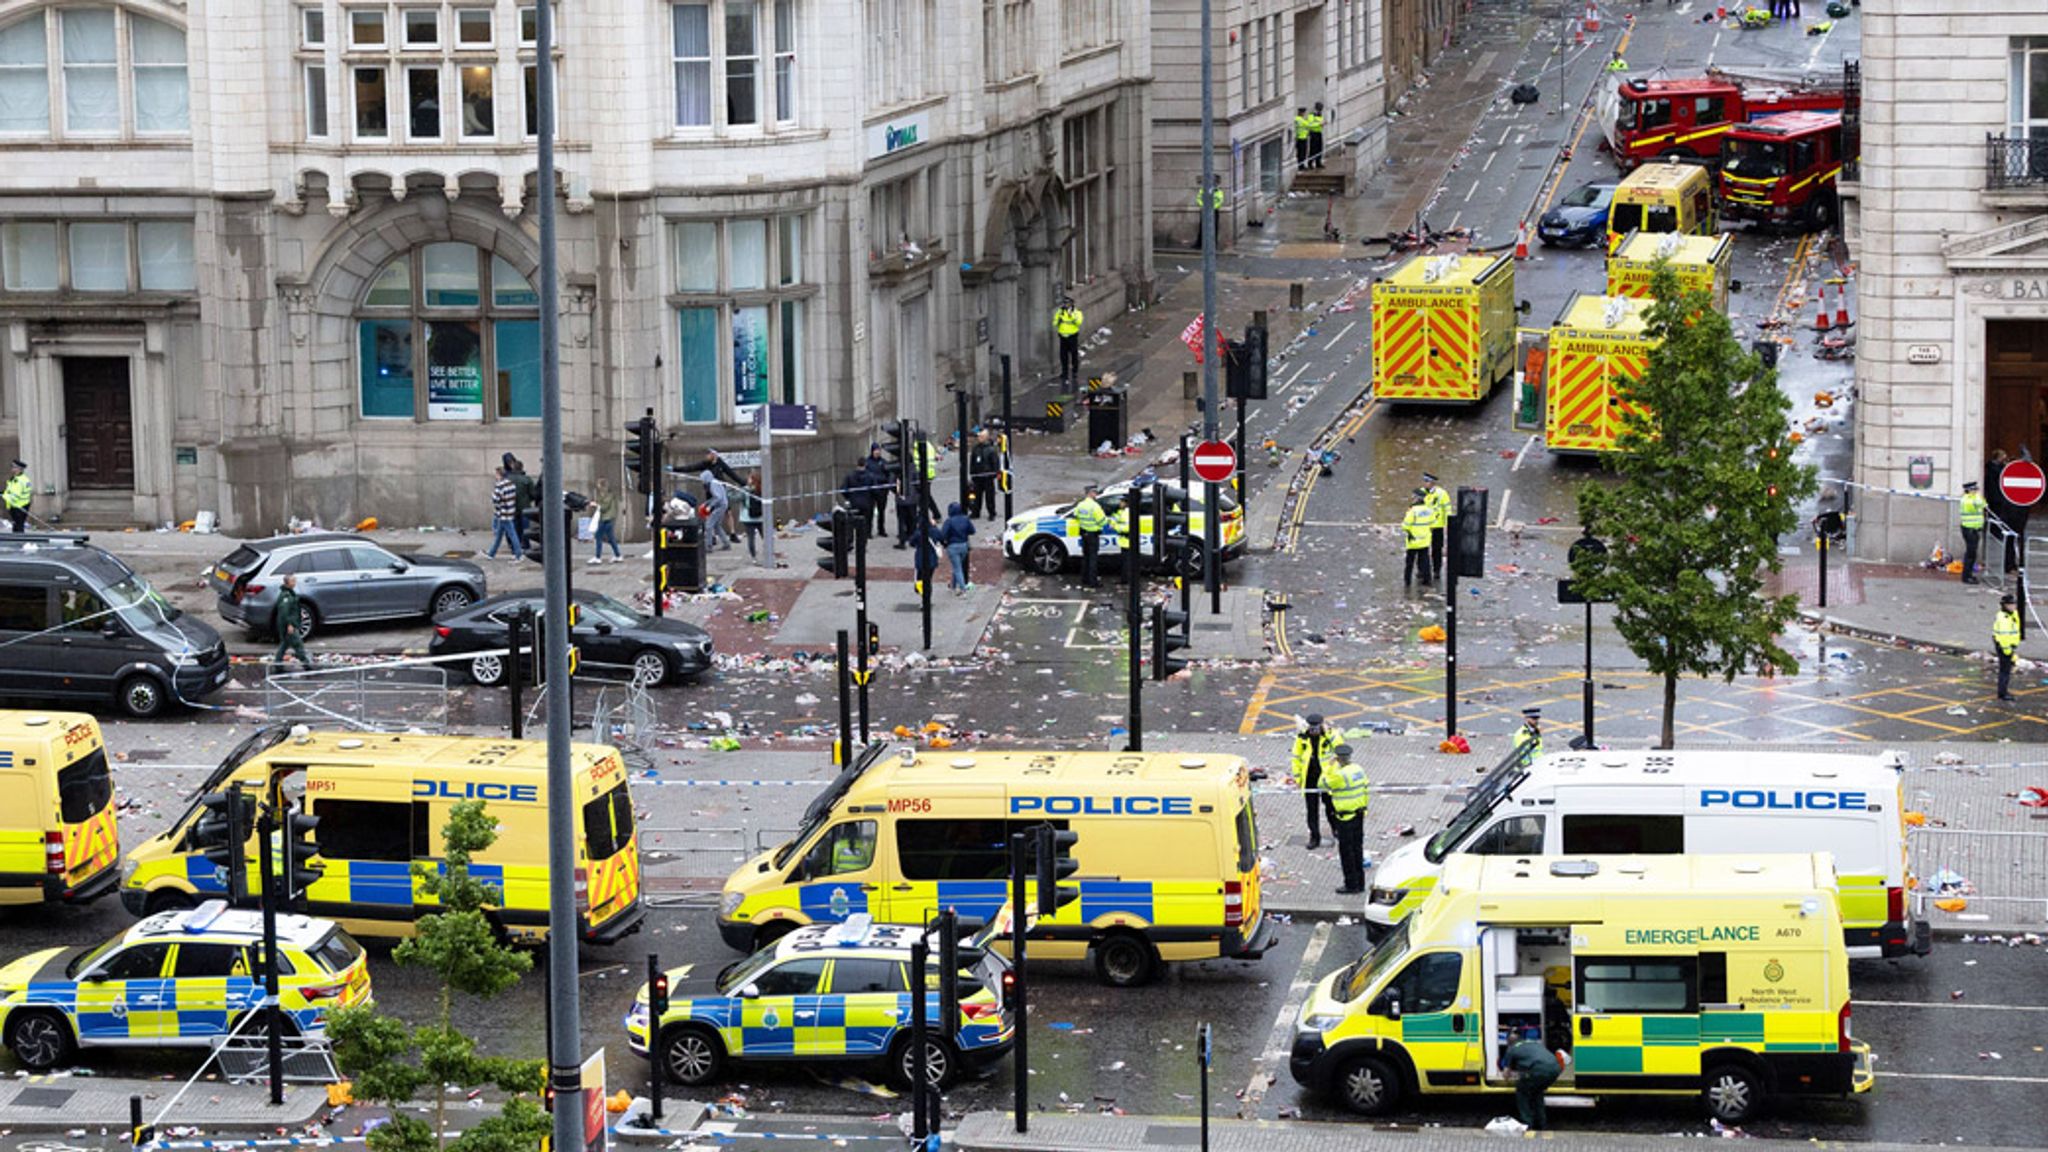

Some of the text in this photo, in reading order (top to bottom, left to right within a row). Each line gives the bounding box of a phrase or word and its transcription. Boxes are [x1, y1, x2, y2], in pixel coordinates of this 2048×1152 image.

[1624, 273, 1697, 286] AMBCE
[1388, 298, 1464, 308] AMBULANCE
[1566, 342, 1648, 355] AMBULANCE
[64, 723, 93, 746] POLICE
[590, 755, 617, 781] POLICE
[306, 780, 336, 791] MP51
[413, 779, 538, 801] OLICE
[888, 799, 932, 813] MP56
[1010, 796, 1192, 815] POLICE
[1700, 789, 1867, 810] POLICE
[1776, 928, 1802, 938] A670
[1738, 996, 1811, 1004] Ambulance Service
